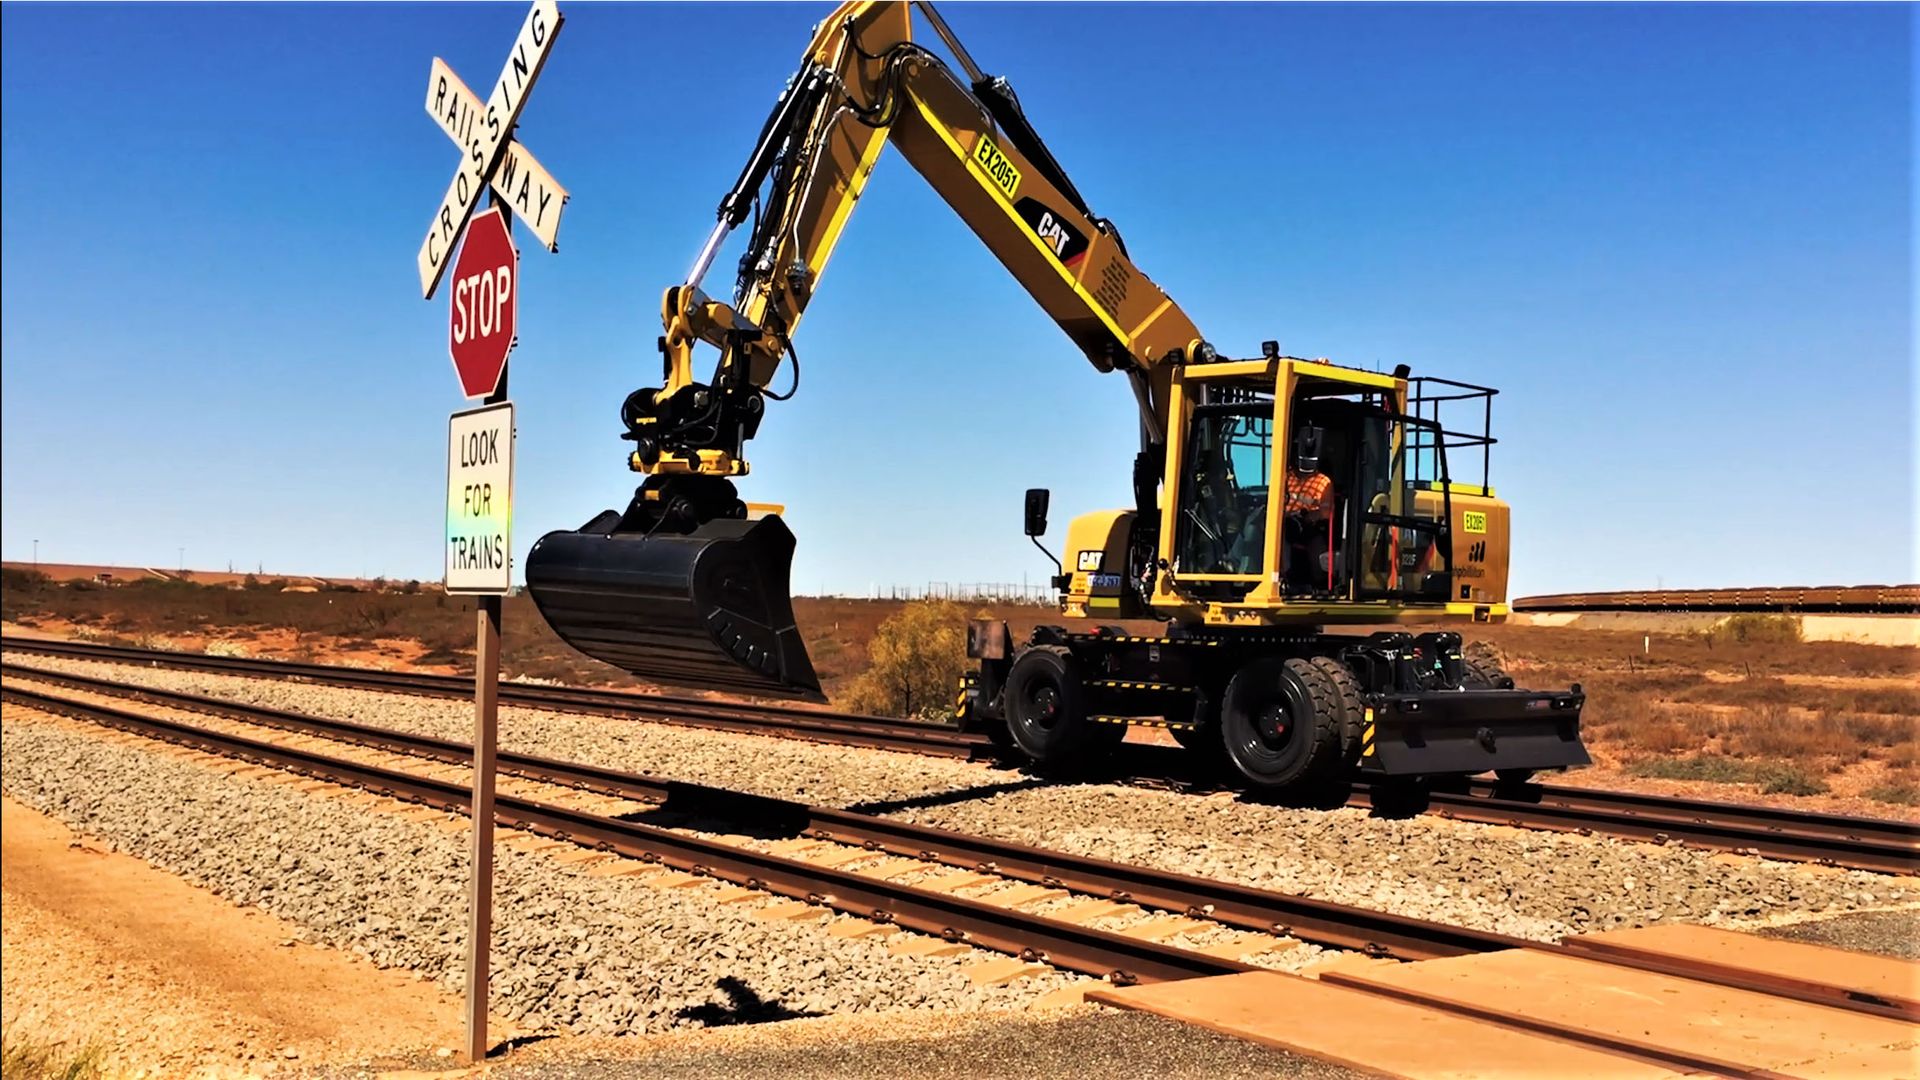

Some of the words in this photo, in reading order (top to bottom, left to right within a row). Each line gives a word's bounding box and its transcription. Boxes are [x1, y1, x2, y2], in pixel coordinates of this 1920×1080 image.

[428, 8, 546, 268] CROSSING
[977, 139, 1018, 193] EX2051
[1037, 212, 1070, 257] CAT
[454, 265, 511, 344] STOP
[461, 428, 499, 467] LOOK
[464, 483, 492, 517] FOR
[451, 534, 503, 570] TRAINS
[1078, 551, 1104, 571] CAT
